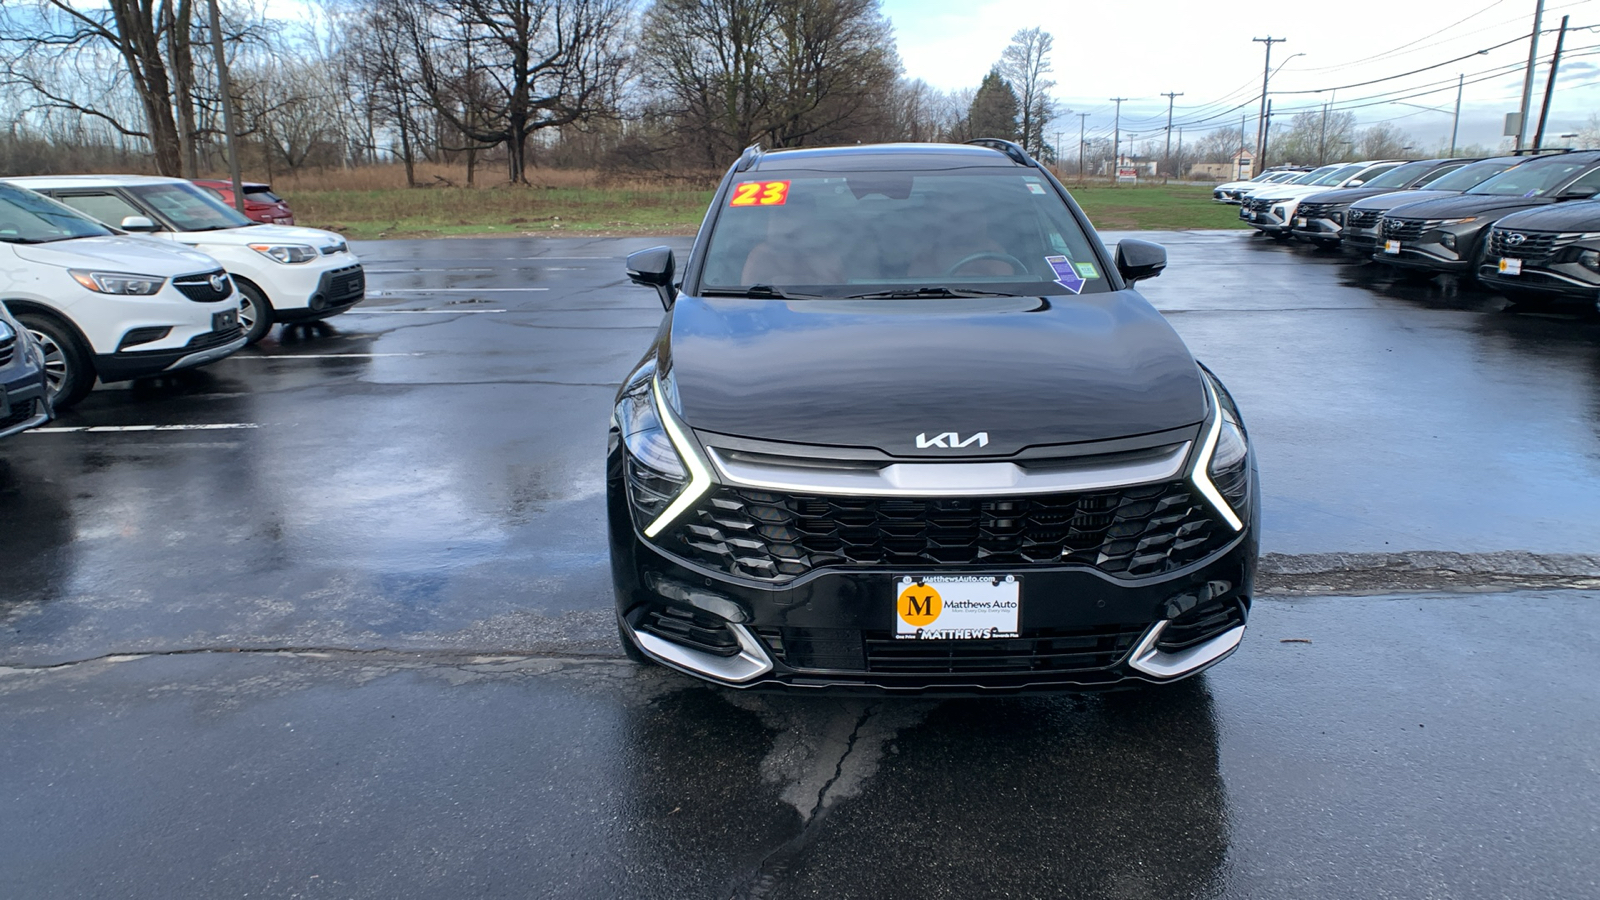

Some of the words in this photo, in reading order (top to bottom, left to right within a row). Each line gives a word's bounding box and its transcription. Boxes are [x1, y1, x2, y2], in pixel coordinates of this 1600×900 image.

[733, 182, 787, 205] 23
[916, 432, 989, 449] KIA
[905, 595, 934, 617] M
[943, 599, 991, 609] Matthews
[992, 599, 1018, 609] Auto
[920, 629, 991, 640] MATTHEWS
